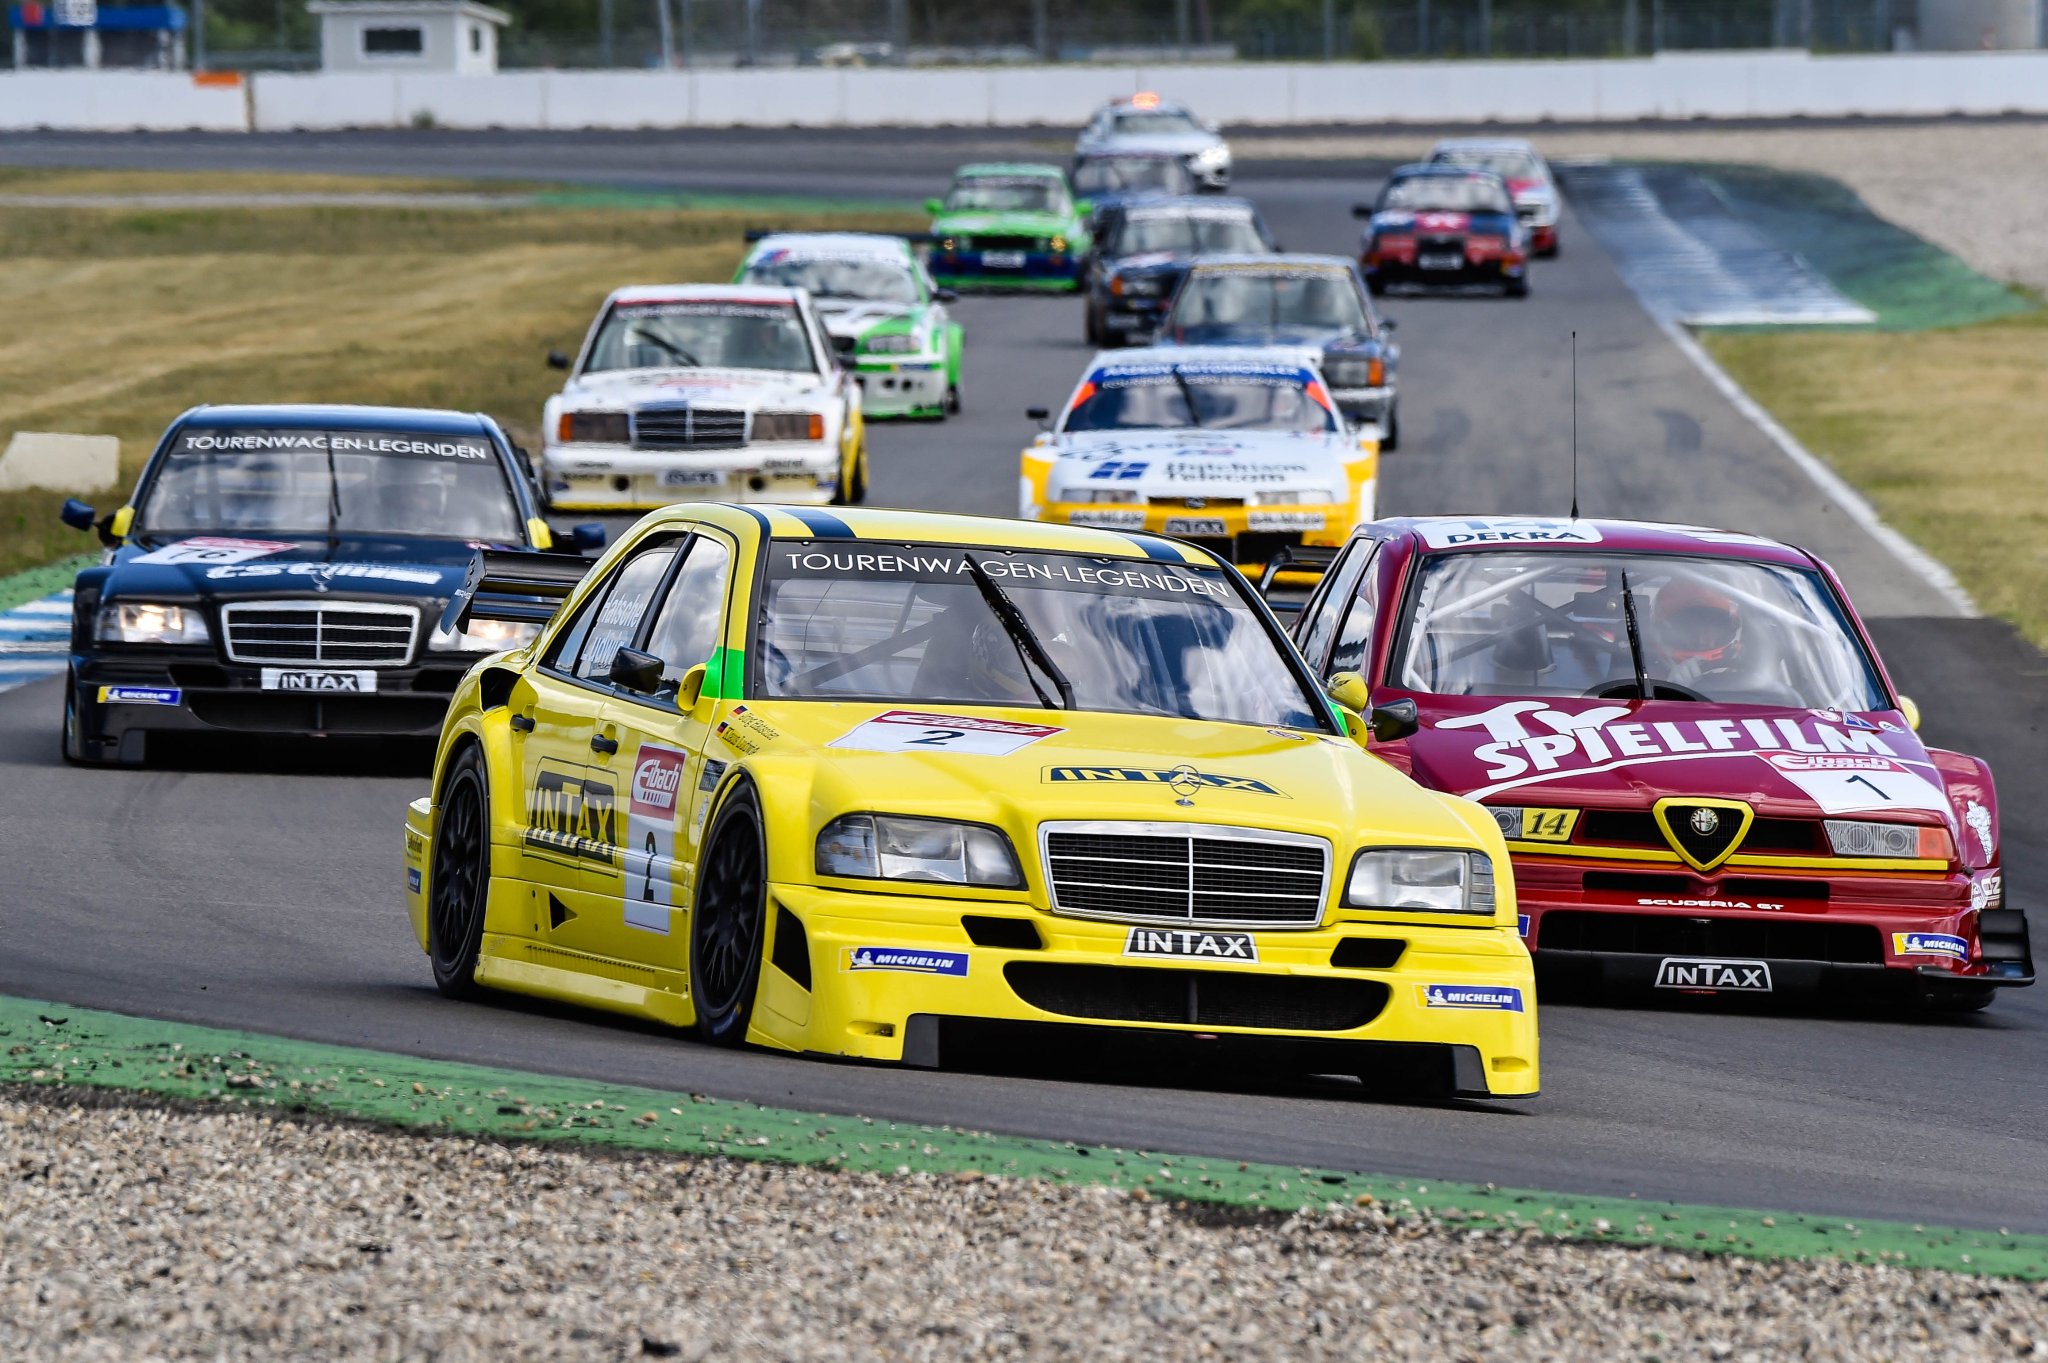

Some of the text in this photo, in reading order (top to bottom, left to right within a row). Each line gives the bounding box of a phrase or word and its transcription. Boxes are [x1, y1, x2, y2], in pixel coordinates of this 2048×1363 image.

[185, 436, 487, 460] TOURENWAGEN-LEGENDEN
[1447, 531, 1586, 544] DEKRA
[786, 552, 1229, 599] TOURENWAGEN-LEGENDEN
[281, 671, 359, 690] INTAX
[904, 730, 965, 746] 2
[1474, 719, 1899, 781] SPIELFILM
[1769, 754, 1891, 770] Eibach
[632, 758, 680, 808] Eibach
[1057, 768, 1260, 791] INTAX
[1845, 774, 1892, 800] 1
[532, 782, 612, 852] INTAX
[1525, 811, 1569, 839] 14
[643, 831, 657, 902] 2
[1637, 898, 1785, 911] SCUDERIA GT
[1137, 930, 1248, 957] INTAX
[1923, 939, 1965, 954] MICHELIN
[875, 954, 954, 968] MICHELIN
[1667, 964, 1764, 988] INTAX
[1447, 992, 1513, 1004] MICHELIN
